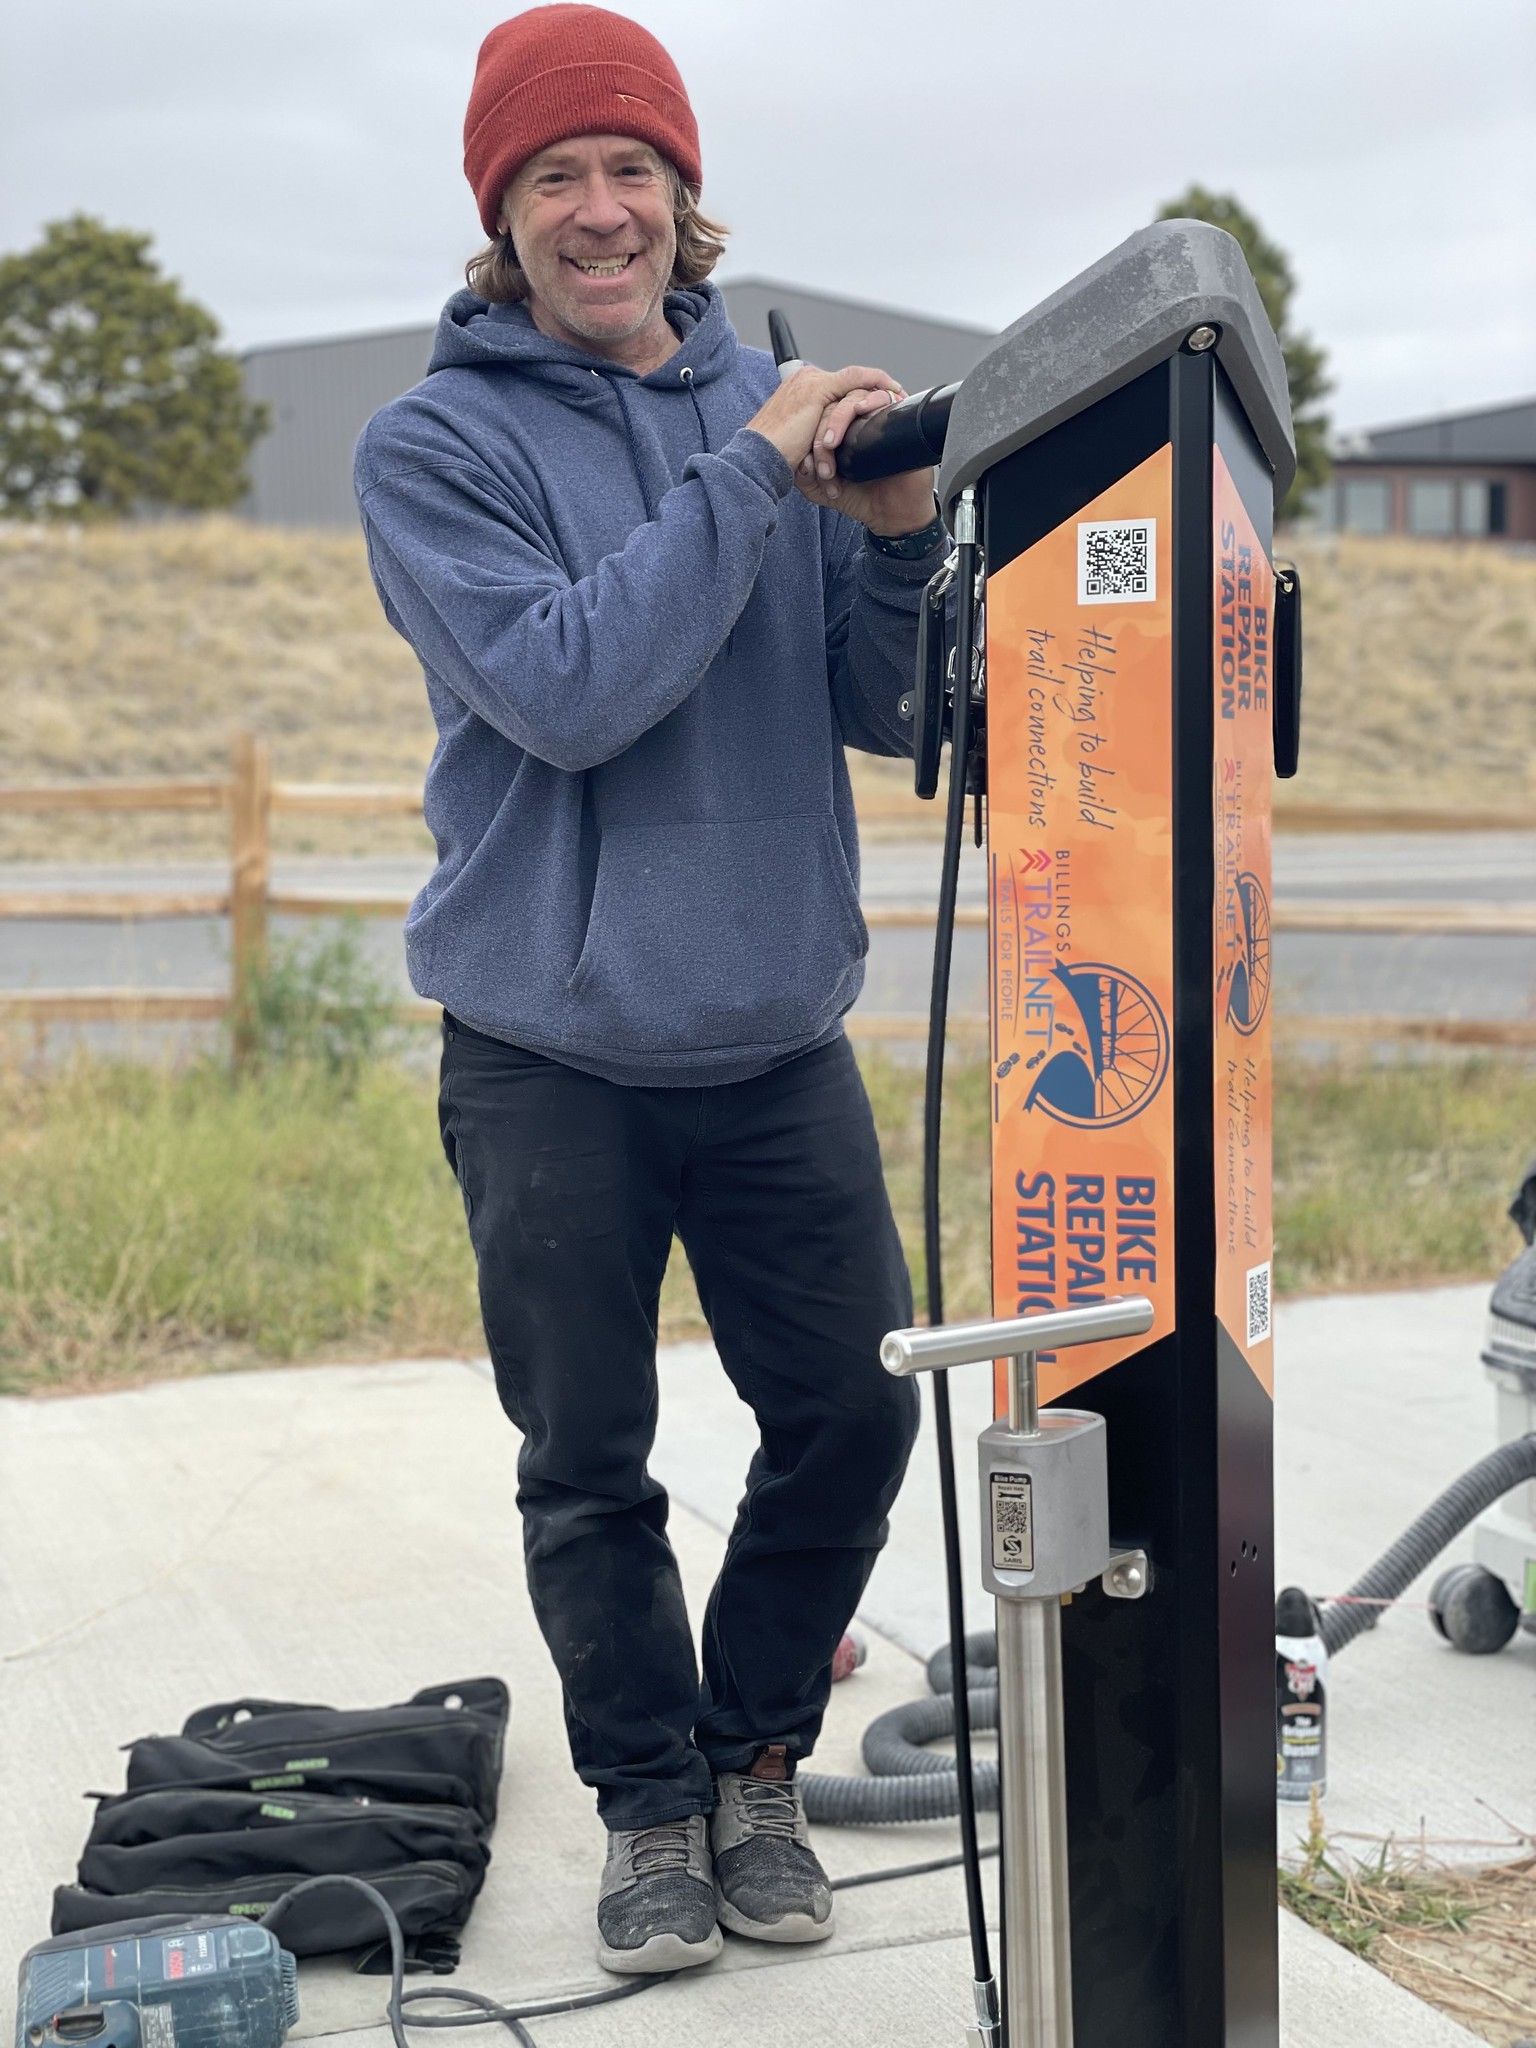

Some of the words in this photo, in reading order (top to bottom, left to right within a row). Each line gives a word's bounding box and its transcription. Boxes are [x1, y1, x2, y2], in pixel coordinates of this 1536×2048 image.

[1026, 628, 1065, 685] trail
[1221, 518, 1235, 720] STATION
[1238, 543, 1252, 711] REPAIR
[1254, 604, 1267, 712] BIKE
[1053, 624, 1117, 723] Helping
[1027, 688, 1057, 828] connections
[1077, 733, 1107, 753] to
[1077, 761, 1117, 830] build
[1000, 878, 1012, 924] TRAILS
[1001, 932, 1012, 961] FOR
[1055, 850, 1071, 952] BILLINGS
[1001, 970, 1013, 1021] PEOPLE
[1023, 877, 1053, 1047] TRAILNET
[1227, 1059, 1241, 1113] trail
[1236, 1058, 1256, 1148] Helping
[1228, 1118, 1238, 1255] connections
[1244, 1157, 1254, 1177] to
[1065, 1173, 1106, 1303] REPAI
[1116, 1175, 1157, 1284] BIKE
[1244, 1186, 1256, 1248] build
